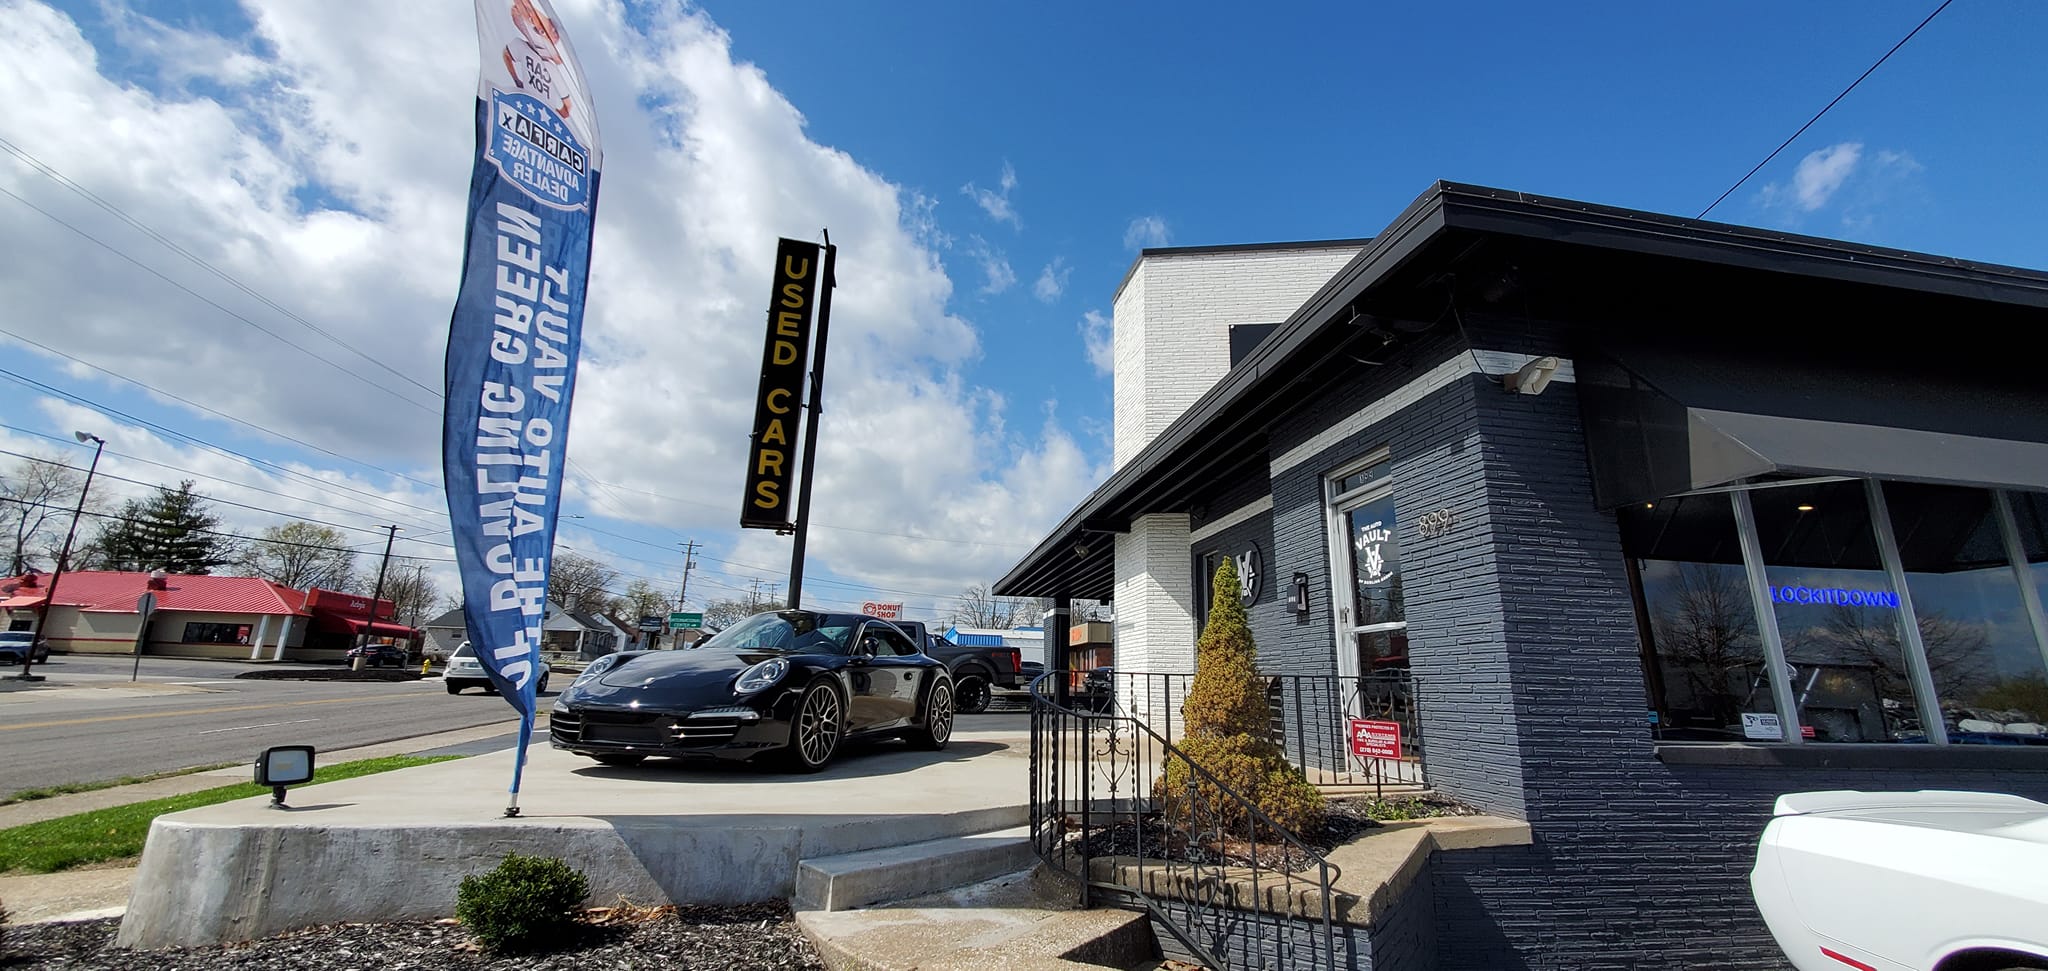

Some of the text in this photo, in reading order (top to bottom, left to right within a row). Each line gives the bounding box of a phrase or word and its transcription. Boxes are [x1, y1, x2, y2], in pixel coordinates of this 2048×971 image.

[754, 255, 808, 510] USED CARS
[1420, 509, 1449, 535] 899
[1355, 529, 1392, 550] VAULT
[877, 604, 901, 612] DONUT
[1356, 729, 1372, 739] AAA
